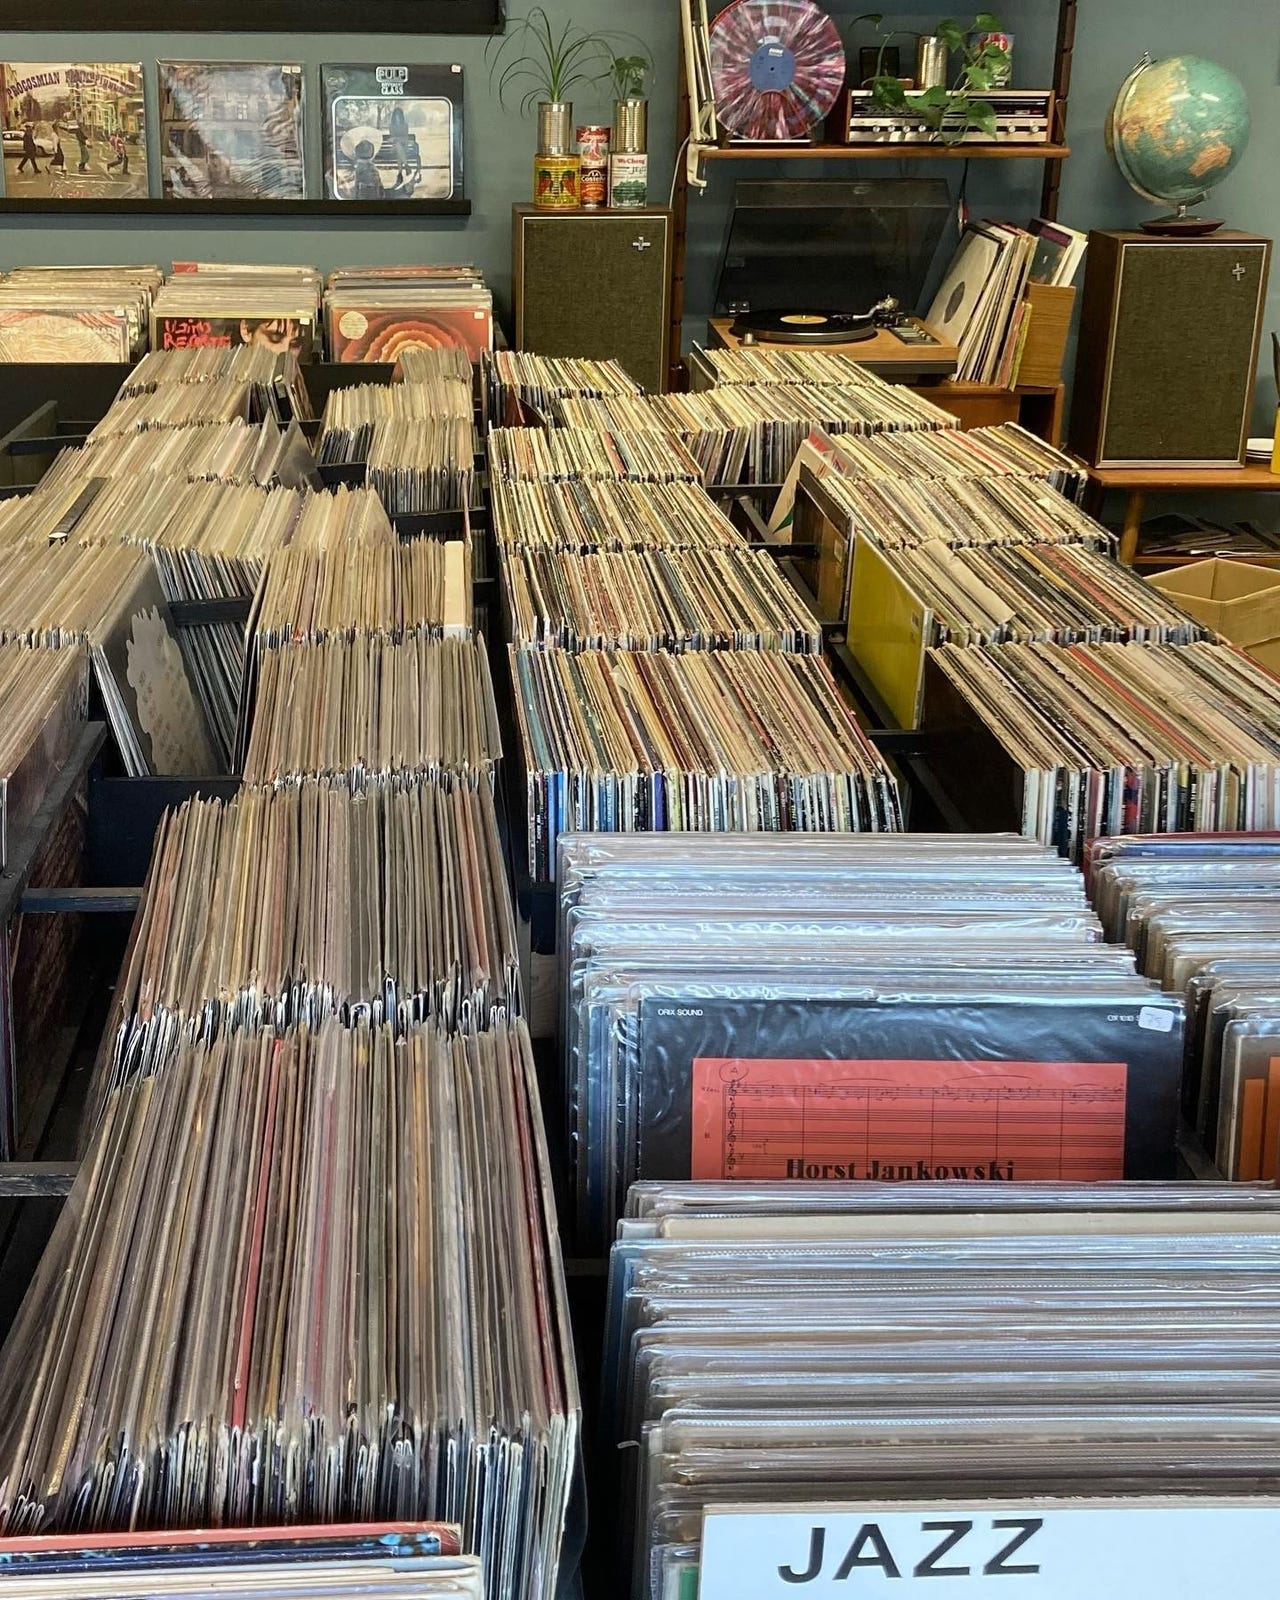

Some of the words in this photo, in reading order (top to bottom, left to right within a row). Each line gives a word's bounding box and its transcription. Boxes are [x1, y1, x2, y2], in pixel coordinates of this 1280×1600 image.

[6, 72, 60, 99] PROCOSMIAN
[378, 68, 406, 80] PULP
[657, 1008, 676, 1016] ORIX
[676, 1008, 704, 1016] SOUND
[785, 1158, 856, 1180] Horst
[866, 1159, 1015, 1181] Jankowski
[777, 1518, 1044, 1584] JAZZ
